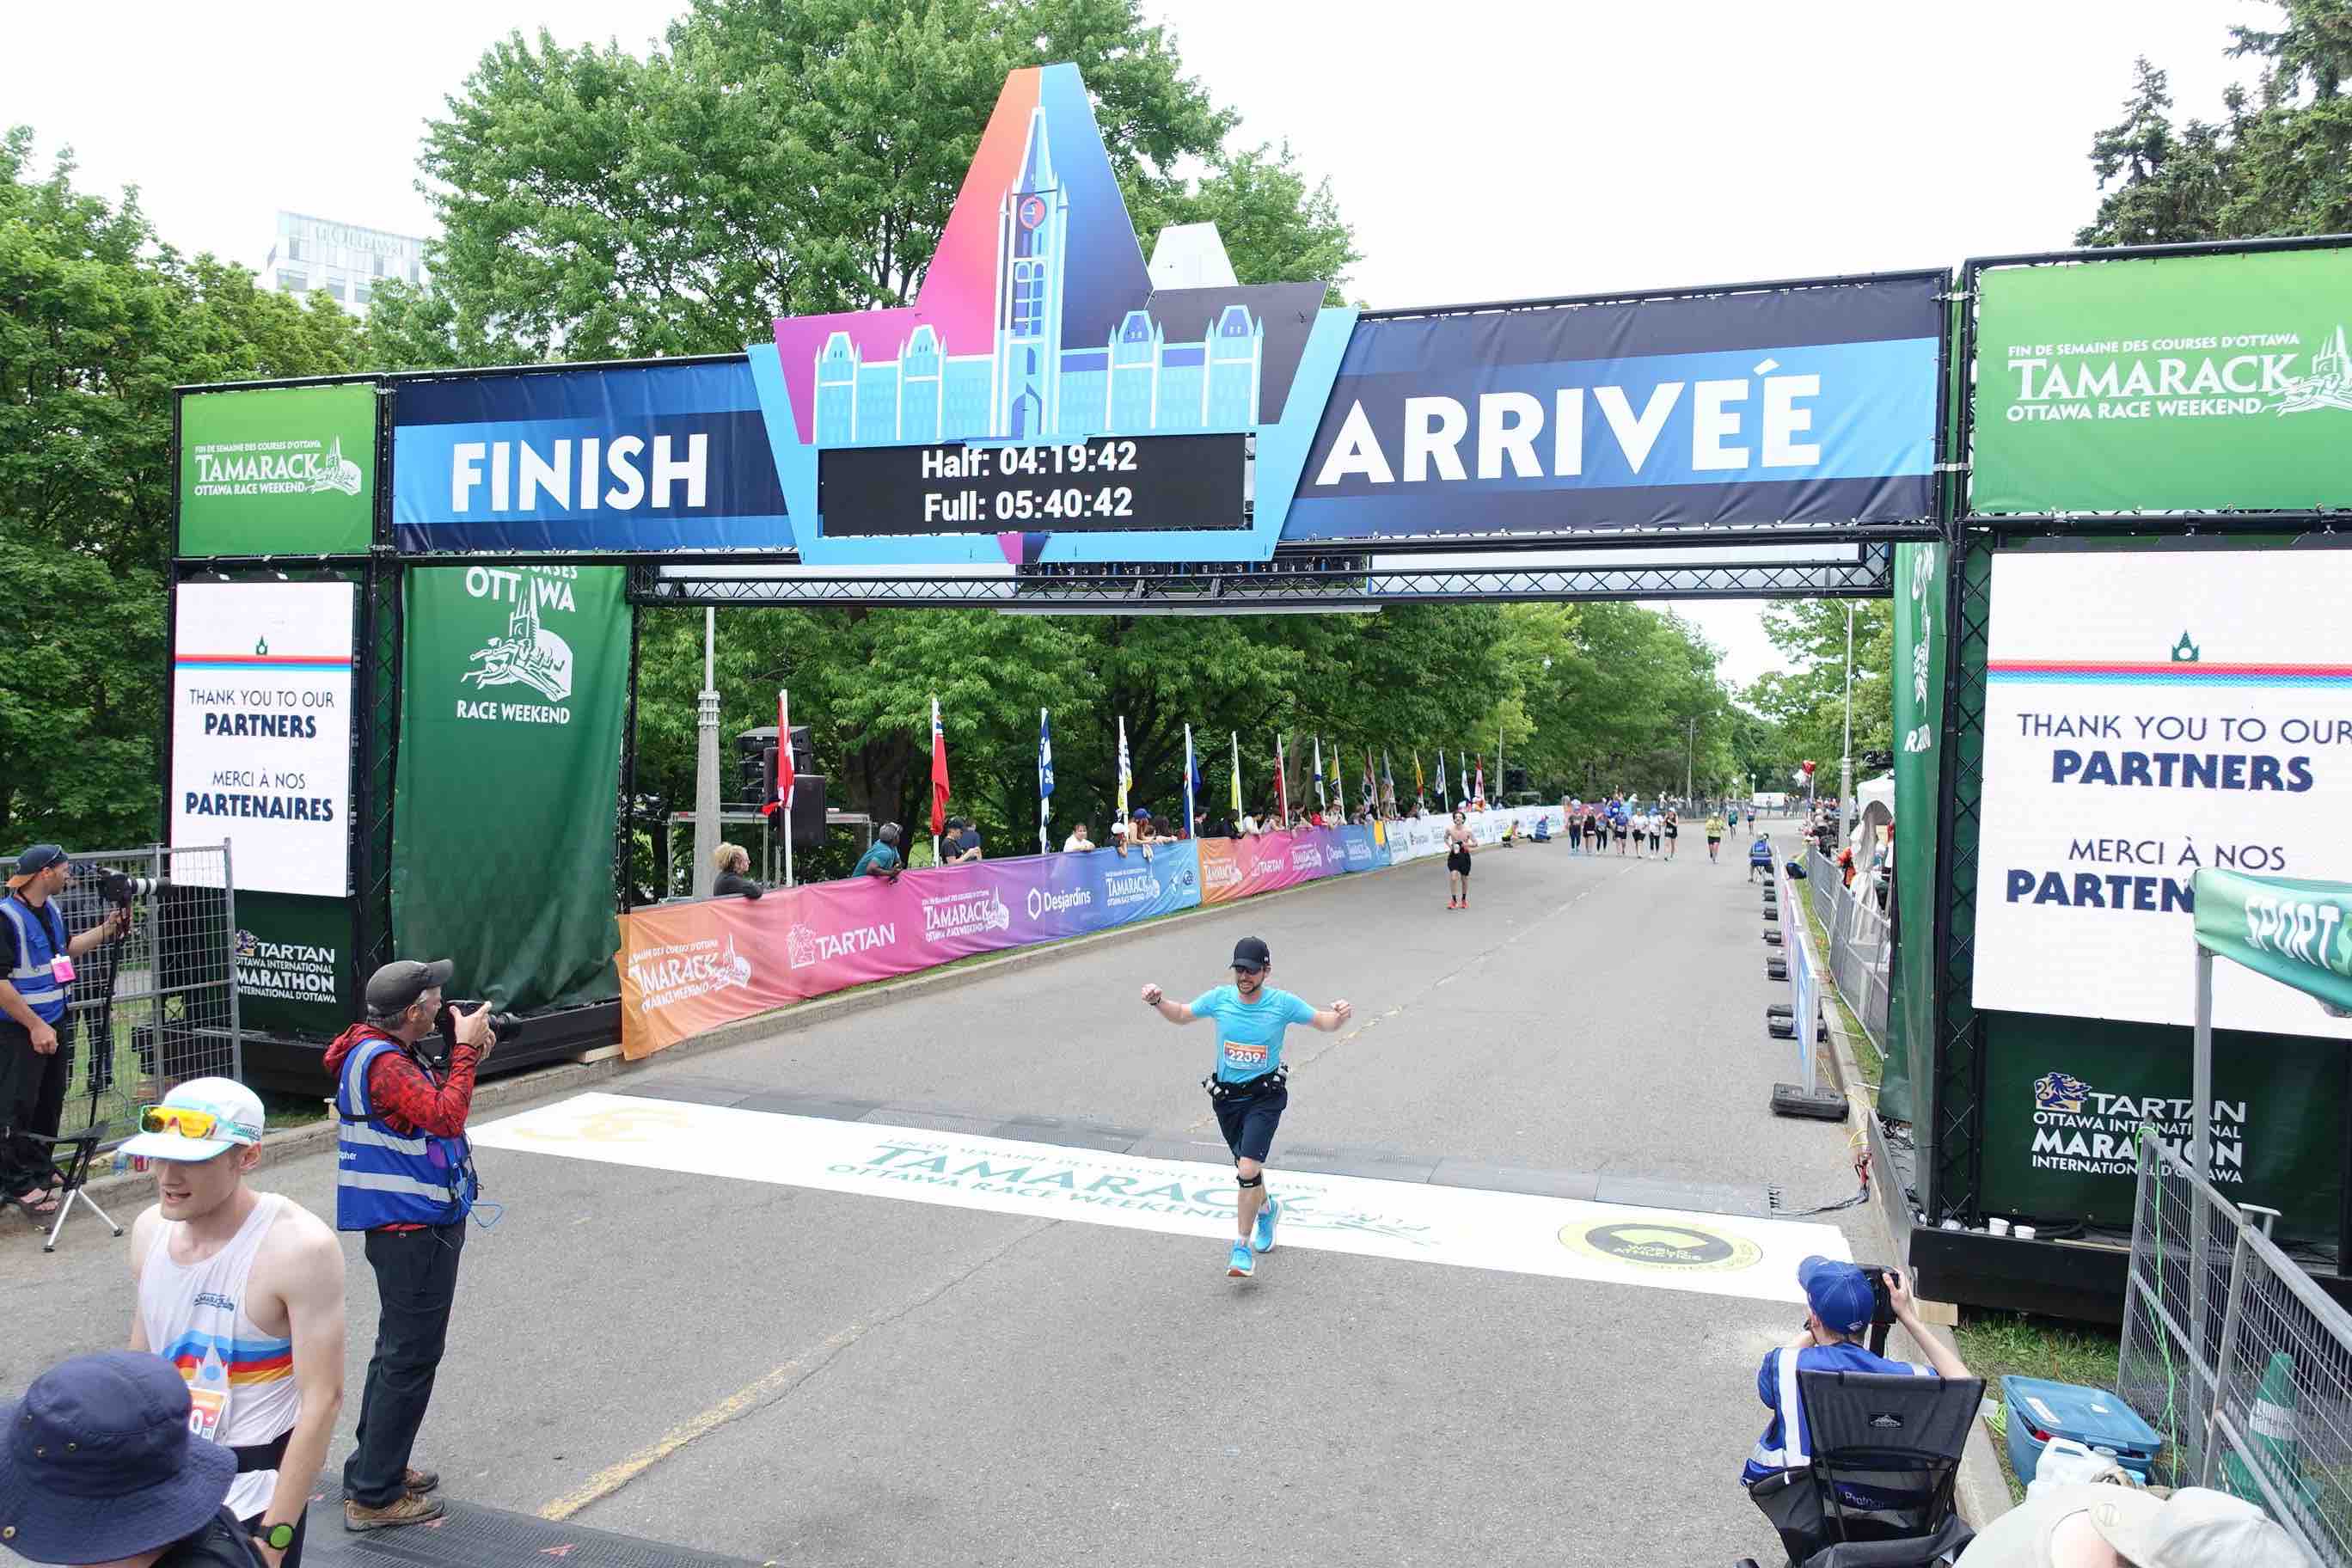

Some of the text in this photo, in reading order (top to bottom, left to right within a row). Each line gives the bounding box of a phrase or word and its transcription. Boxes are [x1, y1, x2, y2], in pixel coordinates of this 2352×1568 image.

[2009, 334, 2300, 357] FIN DE SEMAINE DES COURSES D'OTTAWA
[2008, 353, 2300, 401] TAMARACK
[2006, 398, 2262, 421] OTTAWA RACE WEEKEND
[195, 453, 320, 481] TAMARACK
[452, 433, 707, 512] FINISH
[922, 441, 1137, 478] Half: 04:19:42
[194, 481, 304, 496] OTTAWA RACE WEEKEND
[924, 487, 1133, 521] Full: 05:40:42
[189, 689, 334, 708] THANK YOU TO OUR
[456, 700, 570, 724] RACE WEEKEND
[205, 713, 316, 738] PARTNERS
[2017, 714, 2352, 744] THANK YOU TO OUR
[213, 767, 306, 789] MERCI À NOS
[2052, 750, 2313, 793] PARTNERS
[186, 792, 334, 822] PARTENAIRES
[2068, 836, 2285, 871] MERCI À NOS
[1044, 887, 1091, 913] Desjardins
[2006, 869, 2195, 914] PARTEN
[922, 900, 989, 930] TAMARACK
[257, 942, 334, 963] TARTAN
[814, 922, 895, 961] TARTAN
[236, 957, 333, 974] OTTAWA INTERNATIONAL
[236, 967, 334, 992] MARATHON
[237, 985, 336, 1003] NTERNATIONAL D'OTTAWA
[2032, 1111, 2104, 1130] OTTAWA
[2088, 1093, 2245, 1123] TARTN
[828, 1165, 1238, 1219] OTTAWA RACE WEEKEND
